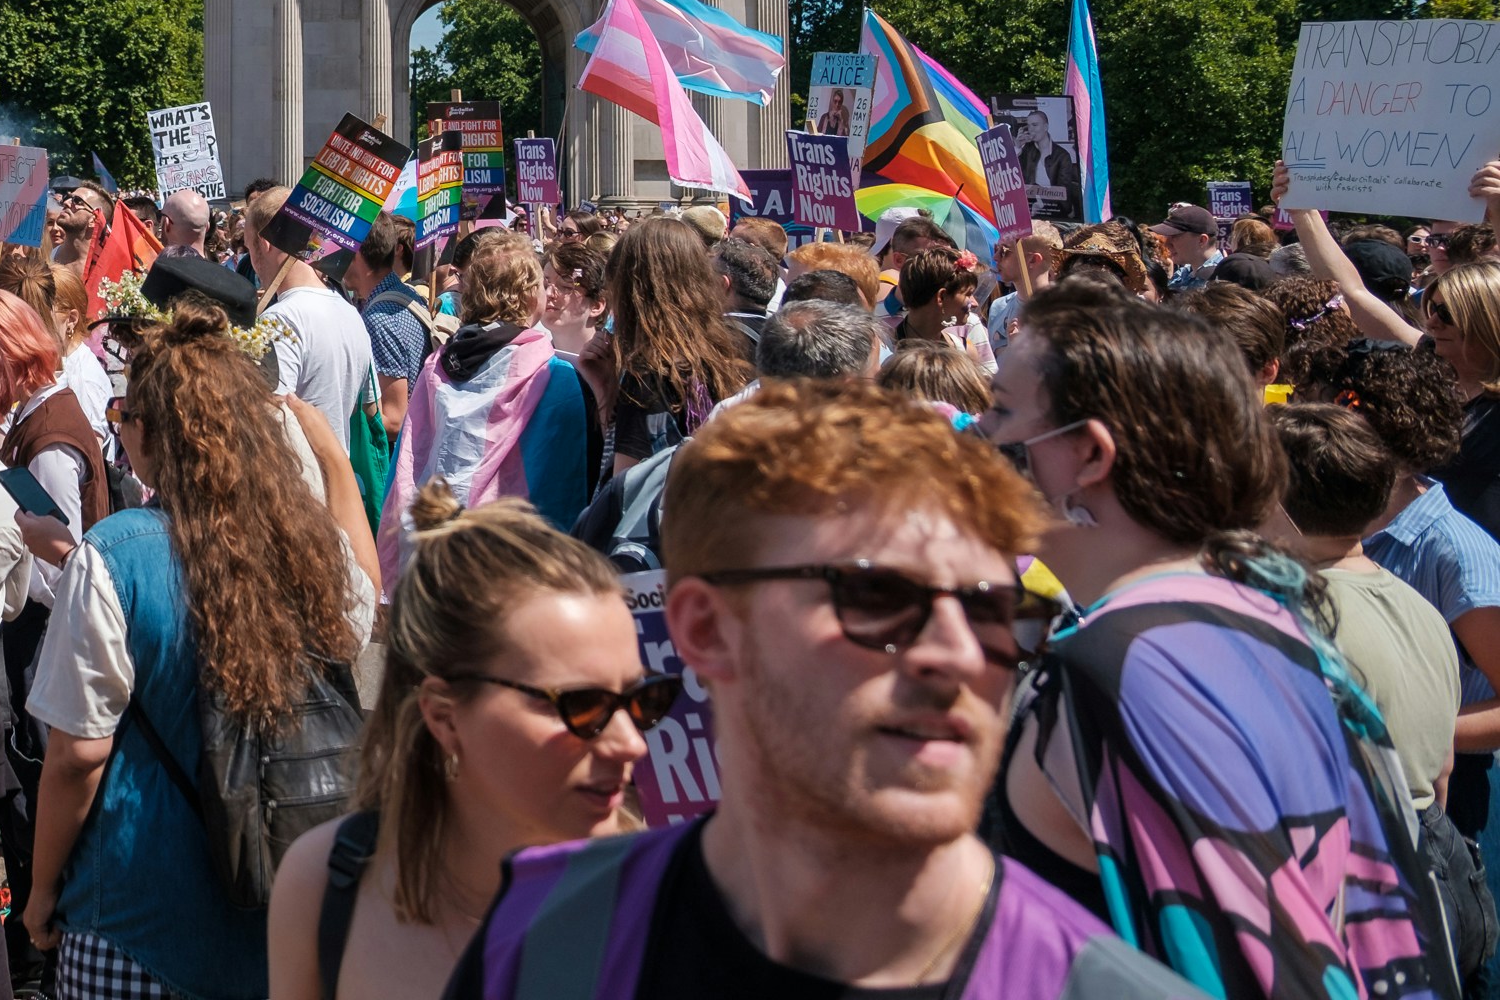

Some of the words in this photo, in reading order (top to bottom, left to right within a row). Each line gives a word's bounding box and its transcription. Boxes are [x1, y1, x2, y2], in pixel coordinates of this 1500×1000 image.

[825, 55, 836, 65] MY
[837, 55, 866, 67] SISTER
[819, 67, 864, 86] ALICE
[809, 97, 819, 108] 23
[856, 98, 867, 110] 26
[1287, 76, 1306, 115] A
[1316, 80, 1423, 117] DANGER
[1445, 83, 1492, 117] TO
[150, 104, 211, 129] WHAT'S
[807, 108, 818, 119] FEB
[853, 111, 867, 122] MAY
[461, 120, 481, 131] FIGHT
[482, 120, 497, 131] FOR
[153, 126, 191, 150] THE
[461, 133, 497, 147] RIGHTS
[1285, 130, 1327, 161] ALL
[159, 154, 180, 167] IT'S
[467, 153, 489, 168] FOR
[515, 140, 546, 160] Trans
[788, 133, 836, 166] Trans
[976, 135, 1007, 165] Trans
[157, 163, 219, 189] TRANS
[377, 162, 396, 179] FOR
[519, 161, 555, 185] Rights
[986, 162, 1022, 201] Rights
[520, 182, 544, 200] Now
[795, 163, 851, 201] Rights
[1315, 182, 1332, 192] with
[312, 175, 342, 202] FIGHT
[338, 189, 364, 214] FOR
[740, 189, 795, 216] CA
[1209, 188, 1242, 201] Trans
[3, 200, 46, 241] YOUTH
[299, 192, 356, 233] SOCIALISM
[798, 194, 835, 226] Now
[993, 199, 1017, 229] Now
[1212, 201, 1250, 218] Rights
